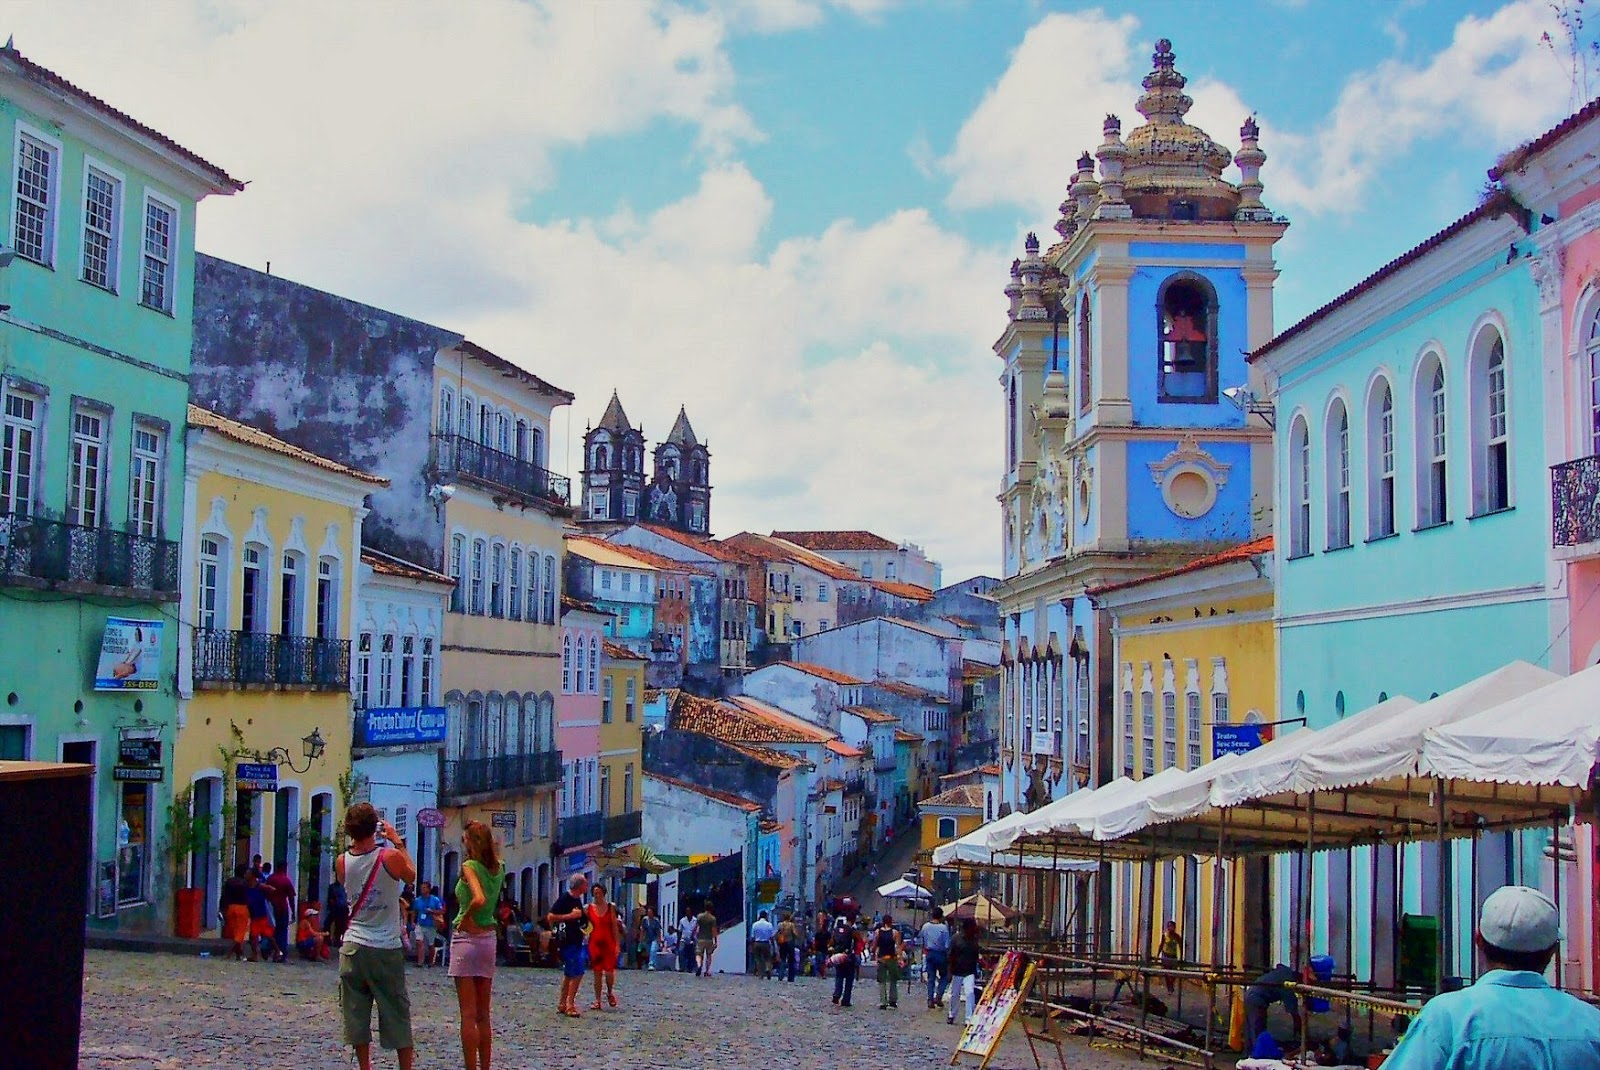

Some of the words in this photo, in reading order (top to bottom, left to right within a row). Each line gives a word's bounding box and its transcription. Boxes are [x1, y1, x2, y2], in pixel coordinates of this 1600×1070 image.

[369, 712, 395, 733] Projeto
[395, 711, 417, 729] Cultural
[122, 748, 149, 756] TATTOO
